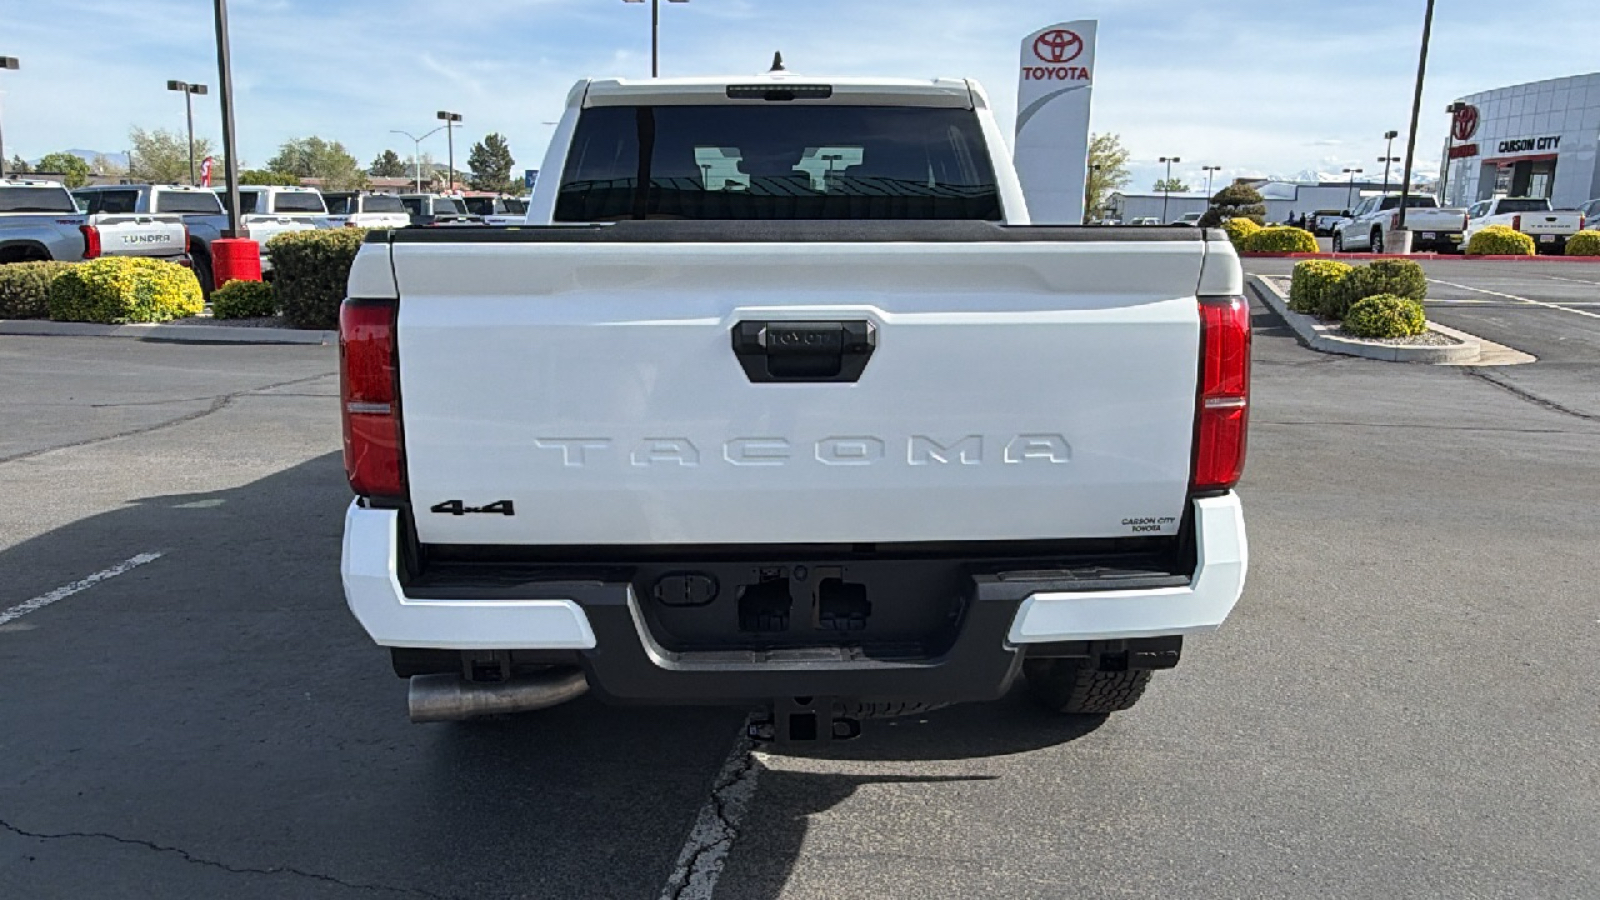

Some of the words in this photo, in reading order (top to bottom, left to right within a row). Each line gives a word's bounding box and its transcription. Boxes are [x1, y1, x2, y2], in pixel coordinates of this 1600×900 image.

[1022, 66, 1089, 81] TOYOTA
[1498, 138, 1536, 153] CARSON
[1537, 135, 1561, 150] CITY
[121, 234, 171, 243] TUNDRA
[769, 332, 835, 345] TOYOT
[534, 435, 1072, 467] TACOMA
